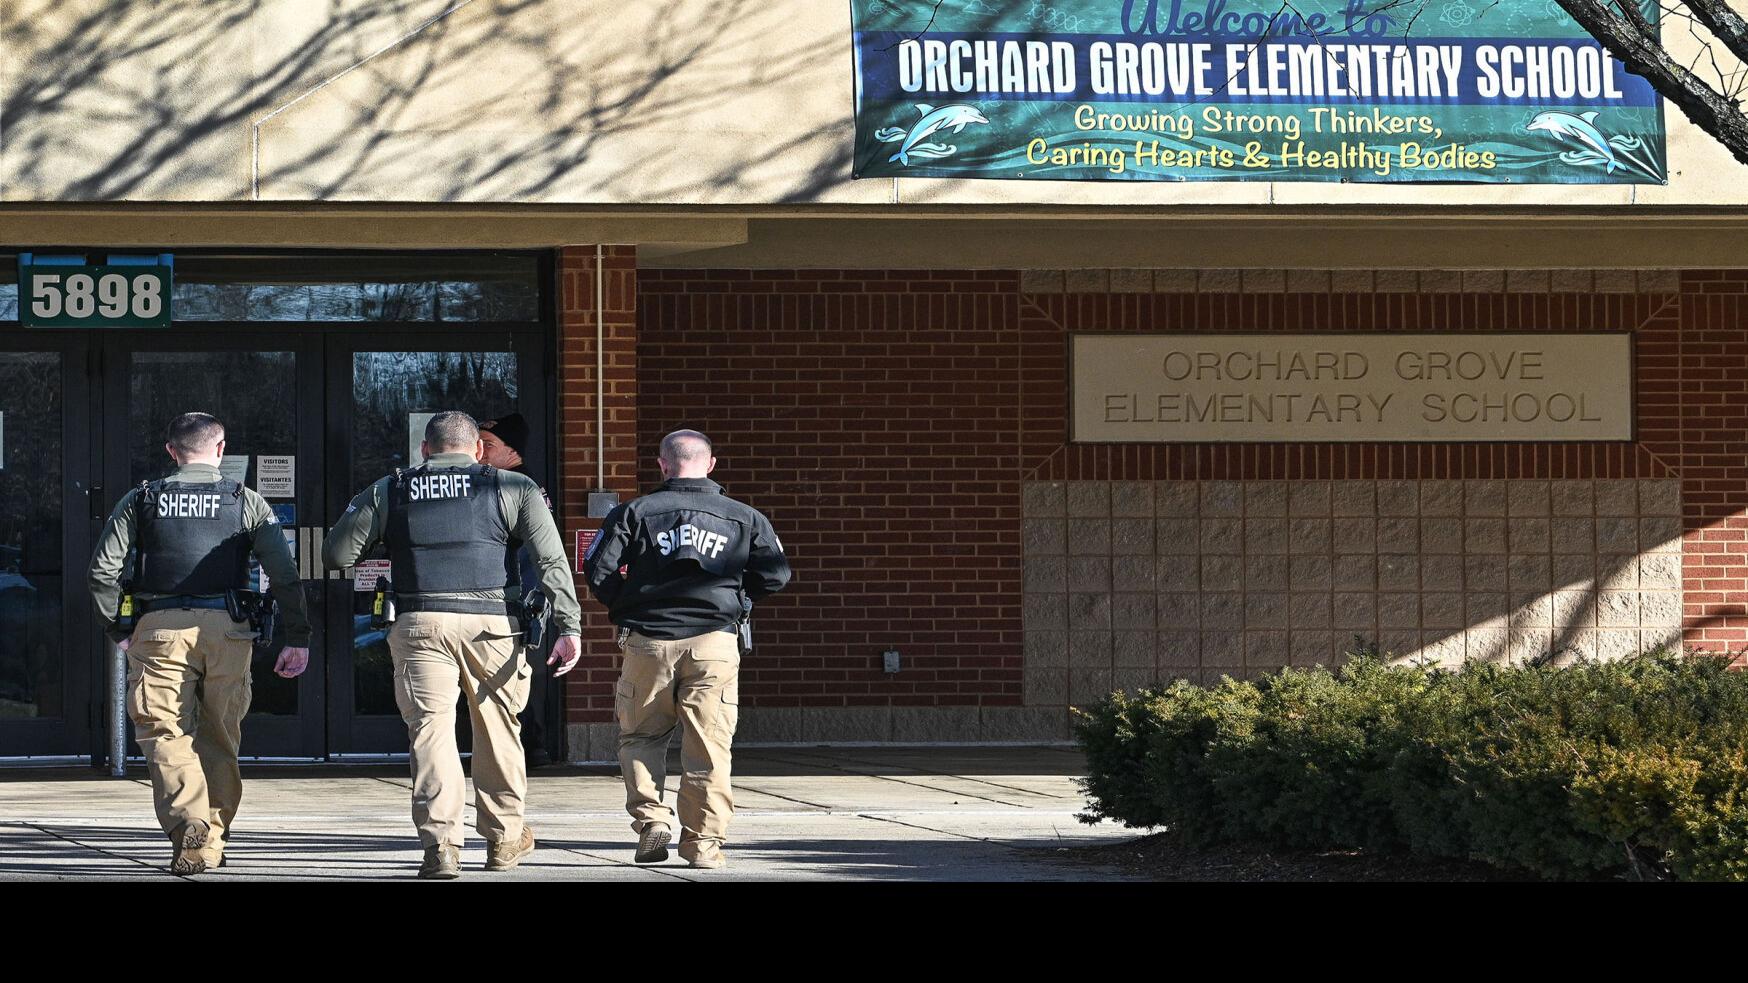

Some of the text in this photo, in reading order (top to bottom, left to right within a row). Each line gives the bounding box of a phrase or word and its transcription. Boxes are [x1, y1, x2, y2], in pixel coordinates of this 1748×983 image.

[1120, 0, 1397, 38] Welcome to
[899, 40, 1623, 99] ORCHARD GROVE ELEMENTARY SCHOOL
[1074, 104, 1442, 140] Growing Strong Thinkers,
[1026, 138, 1497, 176] Caring Hearts & Healthy Bodies
[32, 273, 162, 319] 5898
[1162, 351, 1544, 381] ORCHARD GROVE
[1103, 392, 1602, 423] ELEMENTARY SCHOOL
[410, 474, 471, 500] SHERIFF
[159, 493, 221, 518] SHERIFF
[656, 523, 728, 559] SHERIFF
